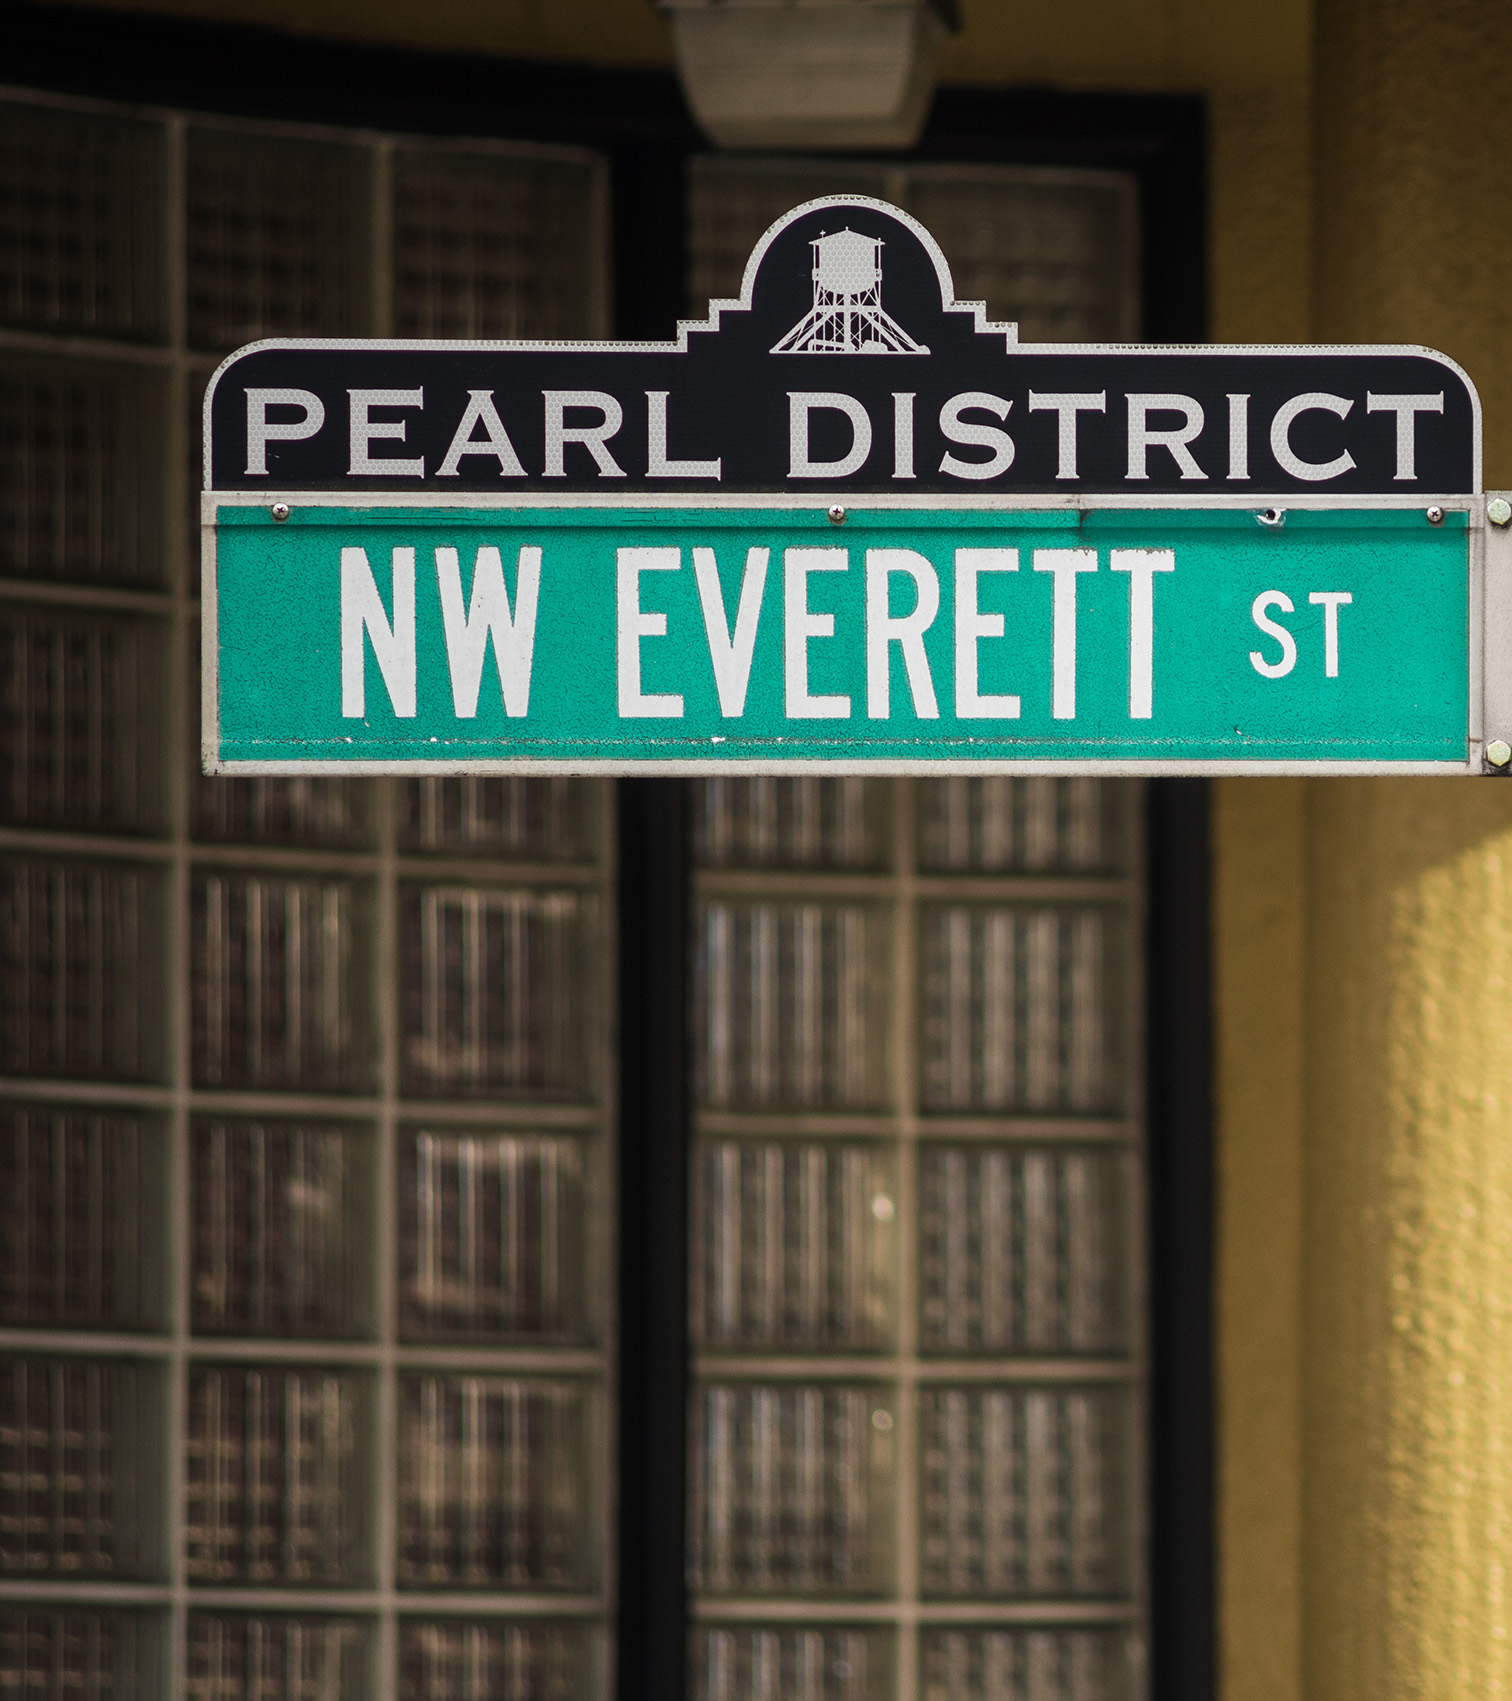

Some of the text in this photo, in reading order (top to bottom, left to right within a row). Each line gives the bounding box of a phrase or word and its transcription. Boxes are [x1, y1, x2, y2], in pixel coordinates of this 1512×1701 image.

[243, 385, 1445, 482] PEARL DISTRICT
[340, 545, 1355, 721] NW EVERETT ST
